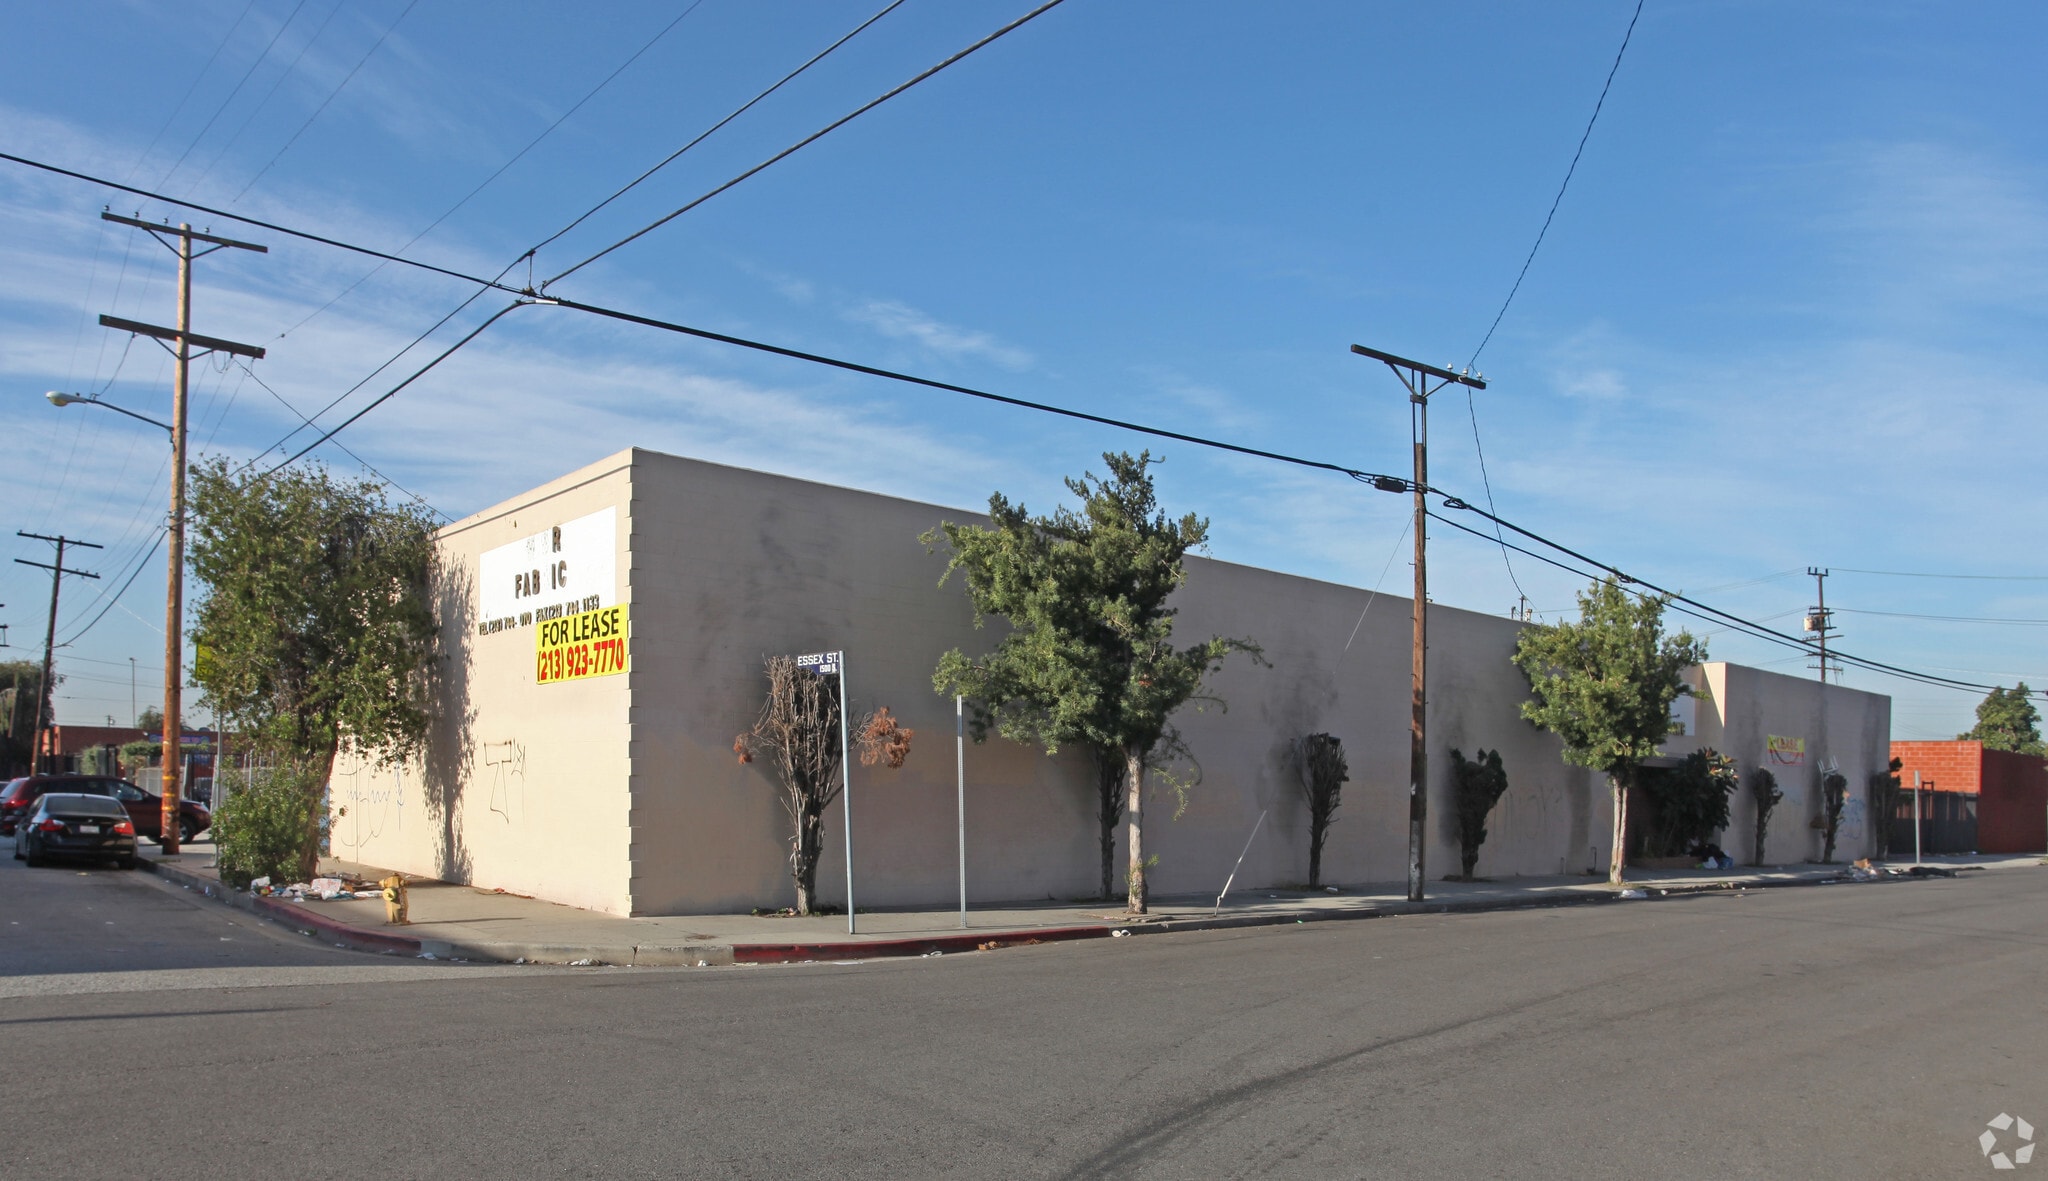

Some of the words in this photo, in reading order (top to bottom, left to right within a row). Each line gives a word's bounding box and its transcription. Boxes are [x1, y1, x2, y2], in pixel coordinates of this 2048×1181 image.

[542, 616, 569, 647] FOR
[573, 609, 620, 642] LEASE
[537, 647, 565, 682] (213)
[567, 637, 624, 678] 923-7770
[797, 654, 824, 666] ESSEX
[827, 652, 839, 663] ST.
